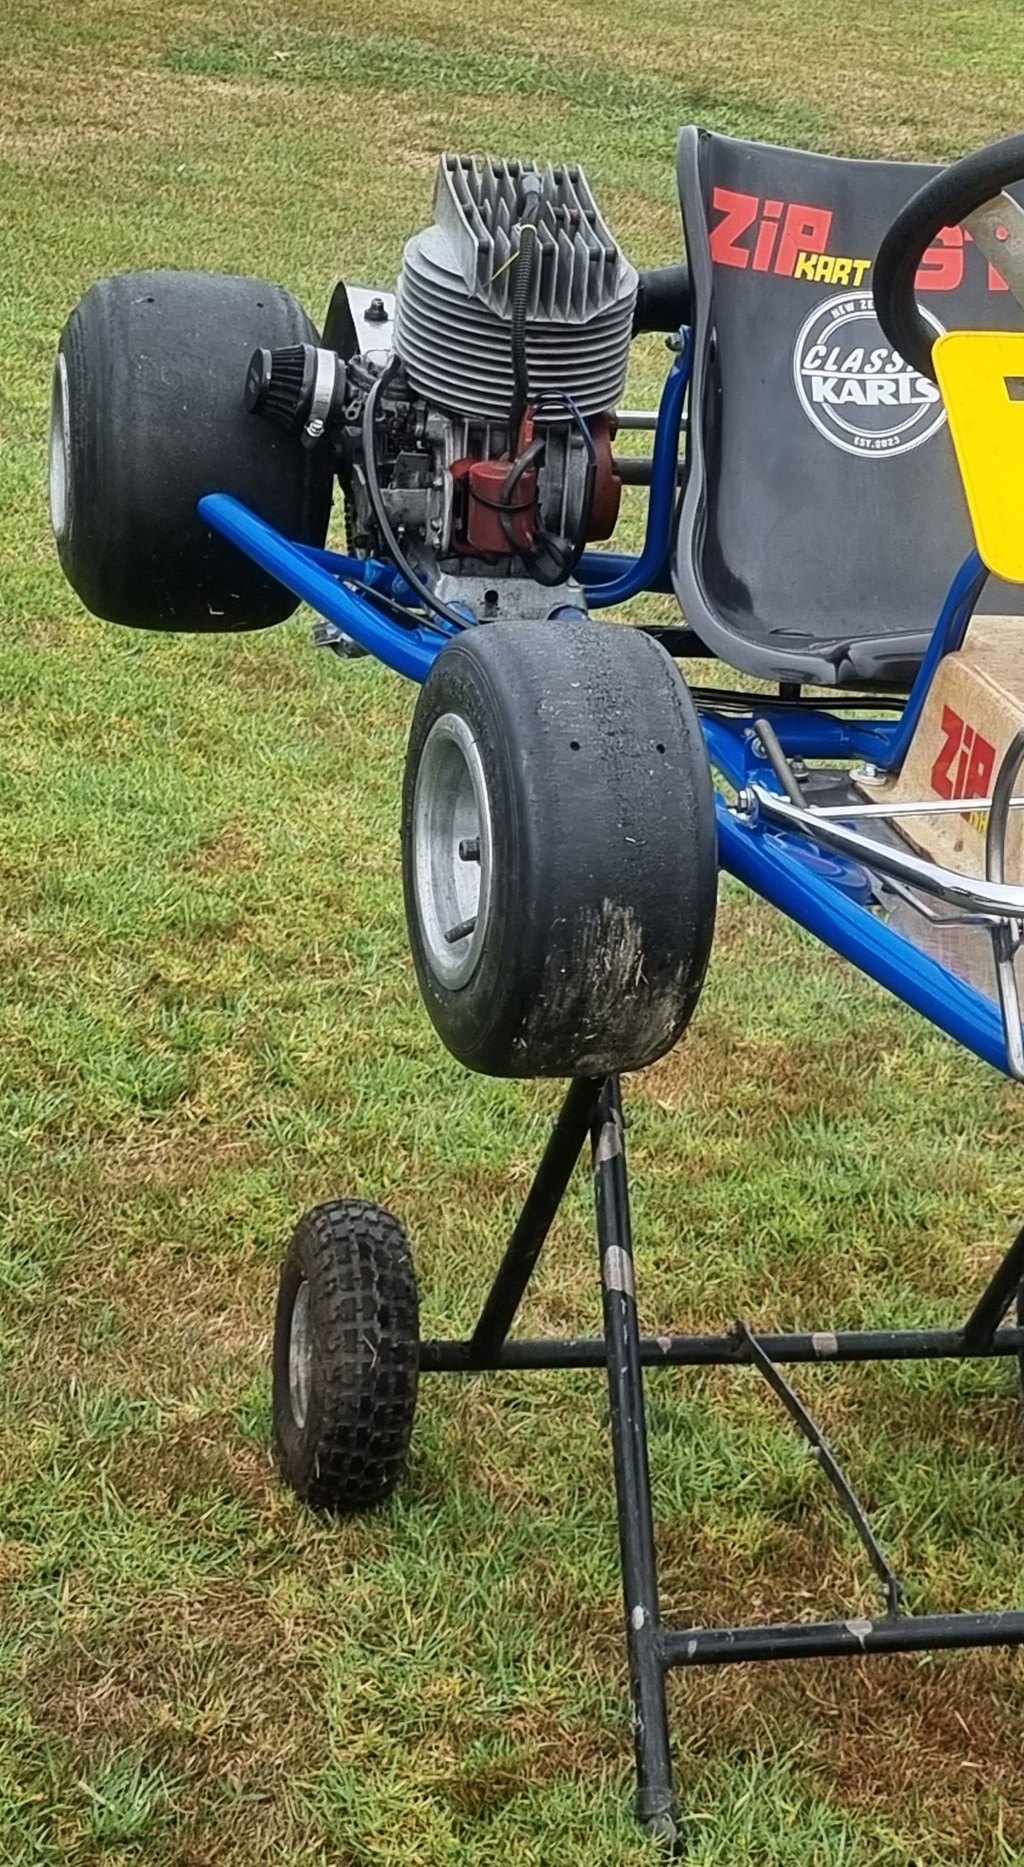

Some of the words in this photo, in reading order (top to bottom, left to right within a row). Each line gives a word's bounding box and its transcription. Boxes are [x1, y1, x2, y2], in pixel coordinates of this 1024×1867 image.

[794, 252, 871, 287] KART
[831, 301, 856, 319] NEW
[803, 344, 915, 373] CLASS
[811, 375, 941, 405] KARTS
